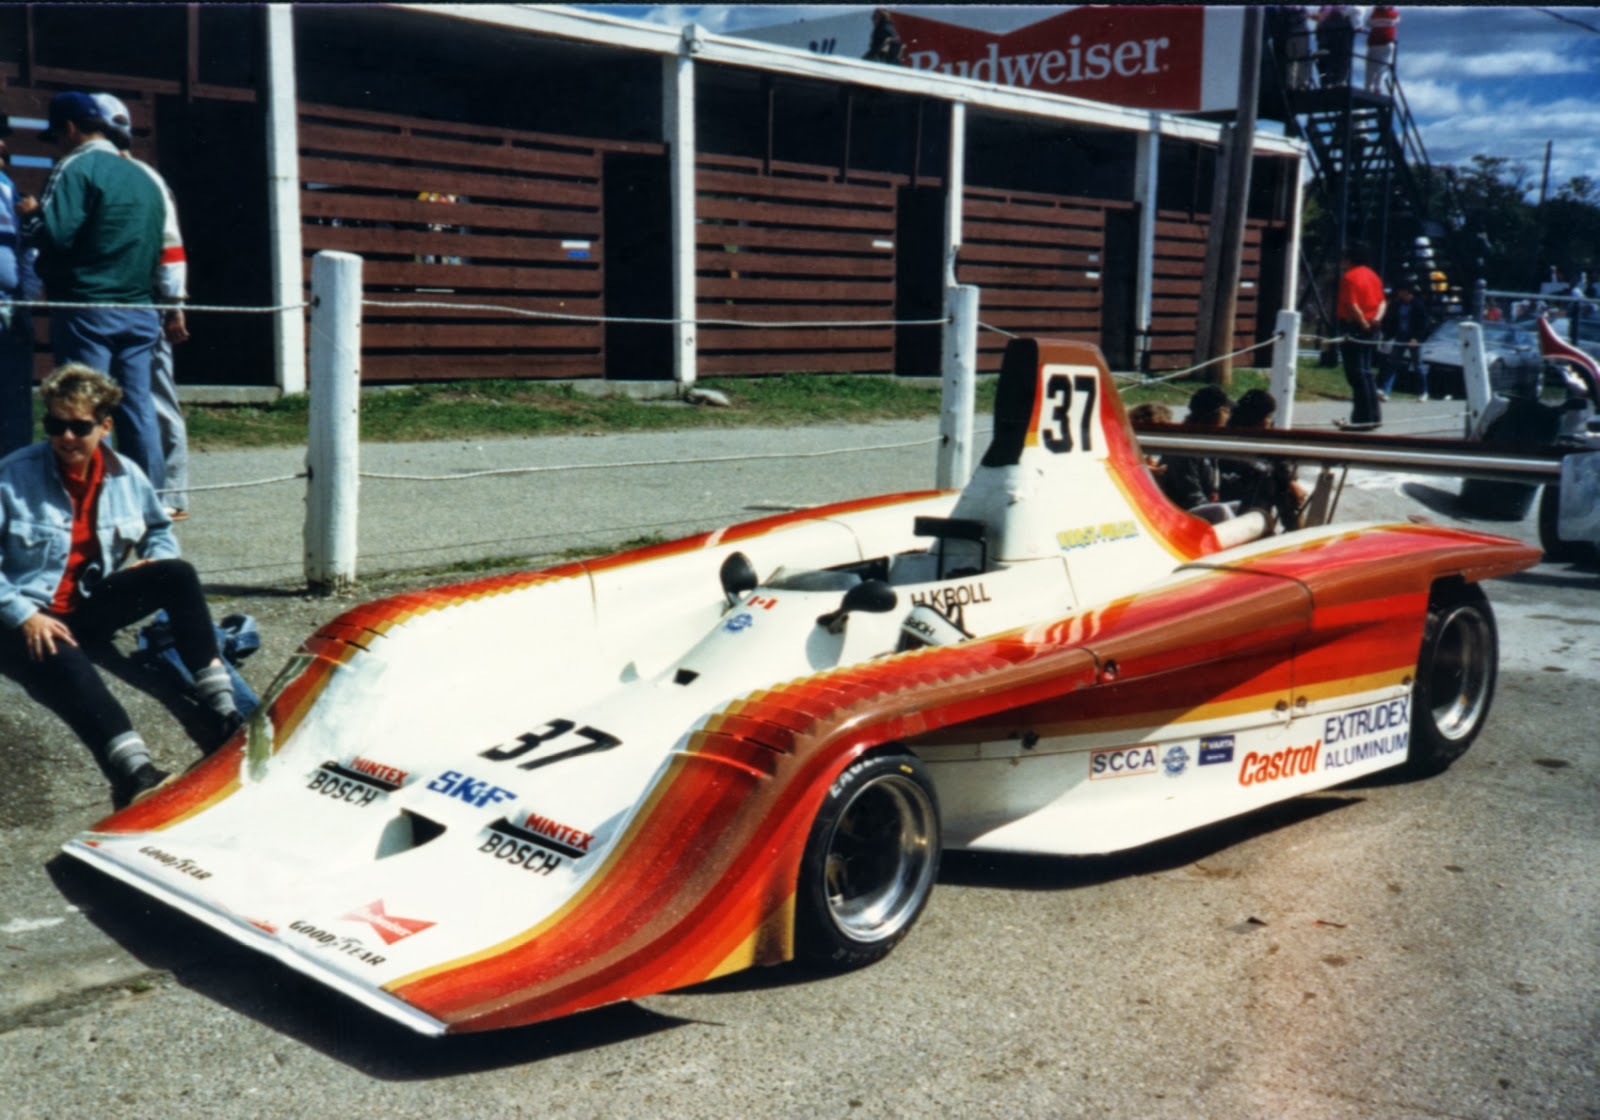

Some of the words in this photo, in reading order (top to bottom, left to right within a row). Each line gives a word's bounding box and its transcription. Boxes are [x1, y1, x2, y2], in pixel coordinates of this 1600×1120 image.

[909, 34, 1170, 87] Budweiser
[1042, 373, 1096, 454] 37
[1323, 695, 1410, 745] EXTRUDEX
[477, 718, 623, 771] 37
[1092, 748, 1156, 774] SCCA
[1238, 739, 1322, 787] Castrol
[1324, 732, 1408, 770] ALUMINUM
[307, 772, 380, 808] BOSCH
[349, 756, 409, 785] MINTEX
[426, 770, 519, 808] SKF
[523, 812, 595, 851] MINTEX
[478, 833, 562, 876] BOSCH
